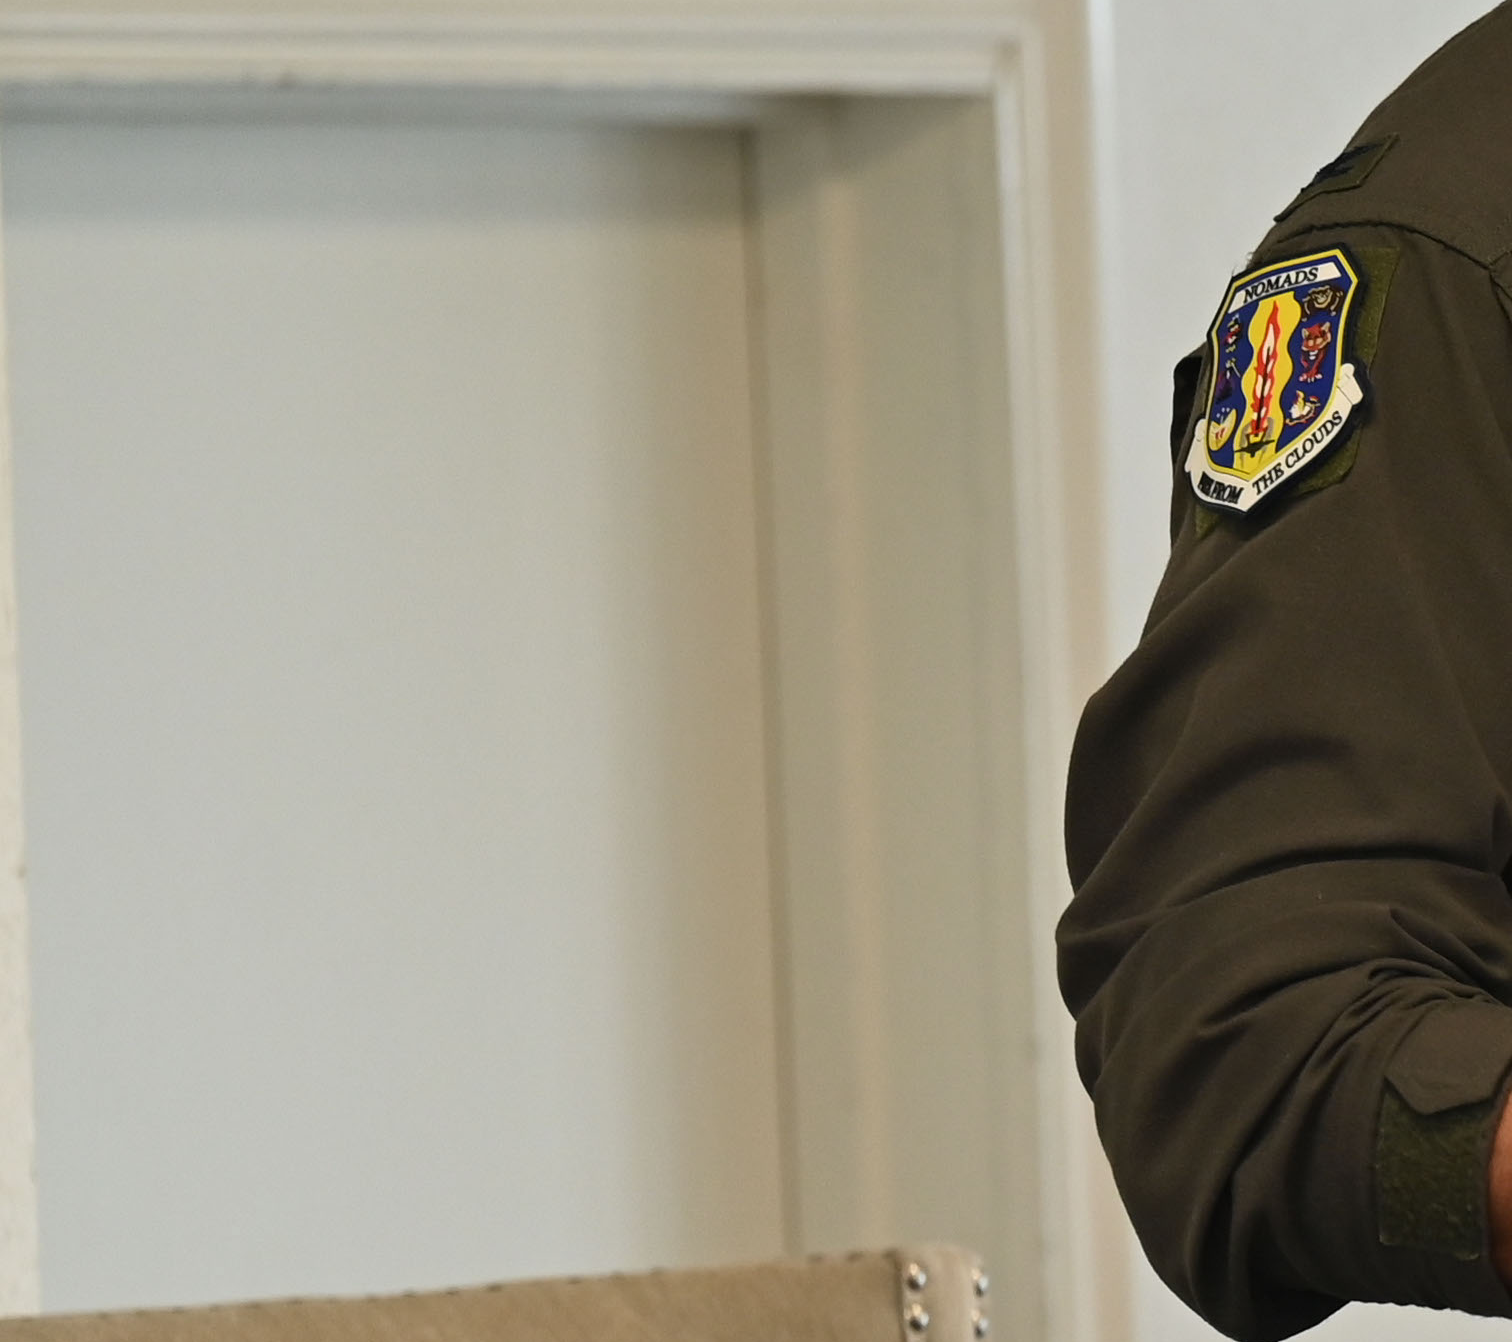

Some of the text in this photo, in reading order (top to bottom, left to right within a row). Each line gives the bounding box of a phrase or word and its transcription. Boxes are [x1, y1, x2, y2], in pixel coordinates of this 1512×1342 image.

[1242, 267, 1319, 305] NOMADS
[1209, 481, 1244, 505] FROM
[1252, 463, 1285, 496] THE
[1284, 410, 1343, 470] CLOUDS
